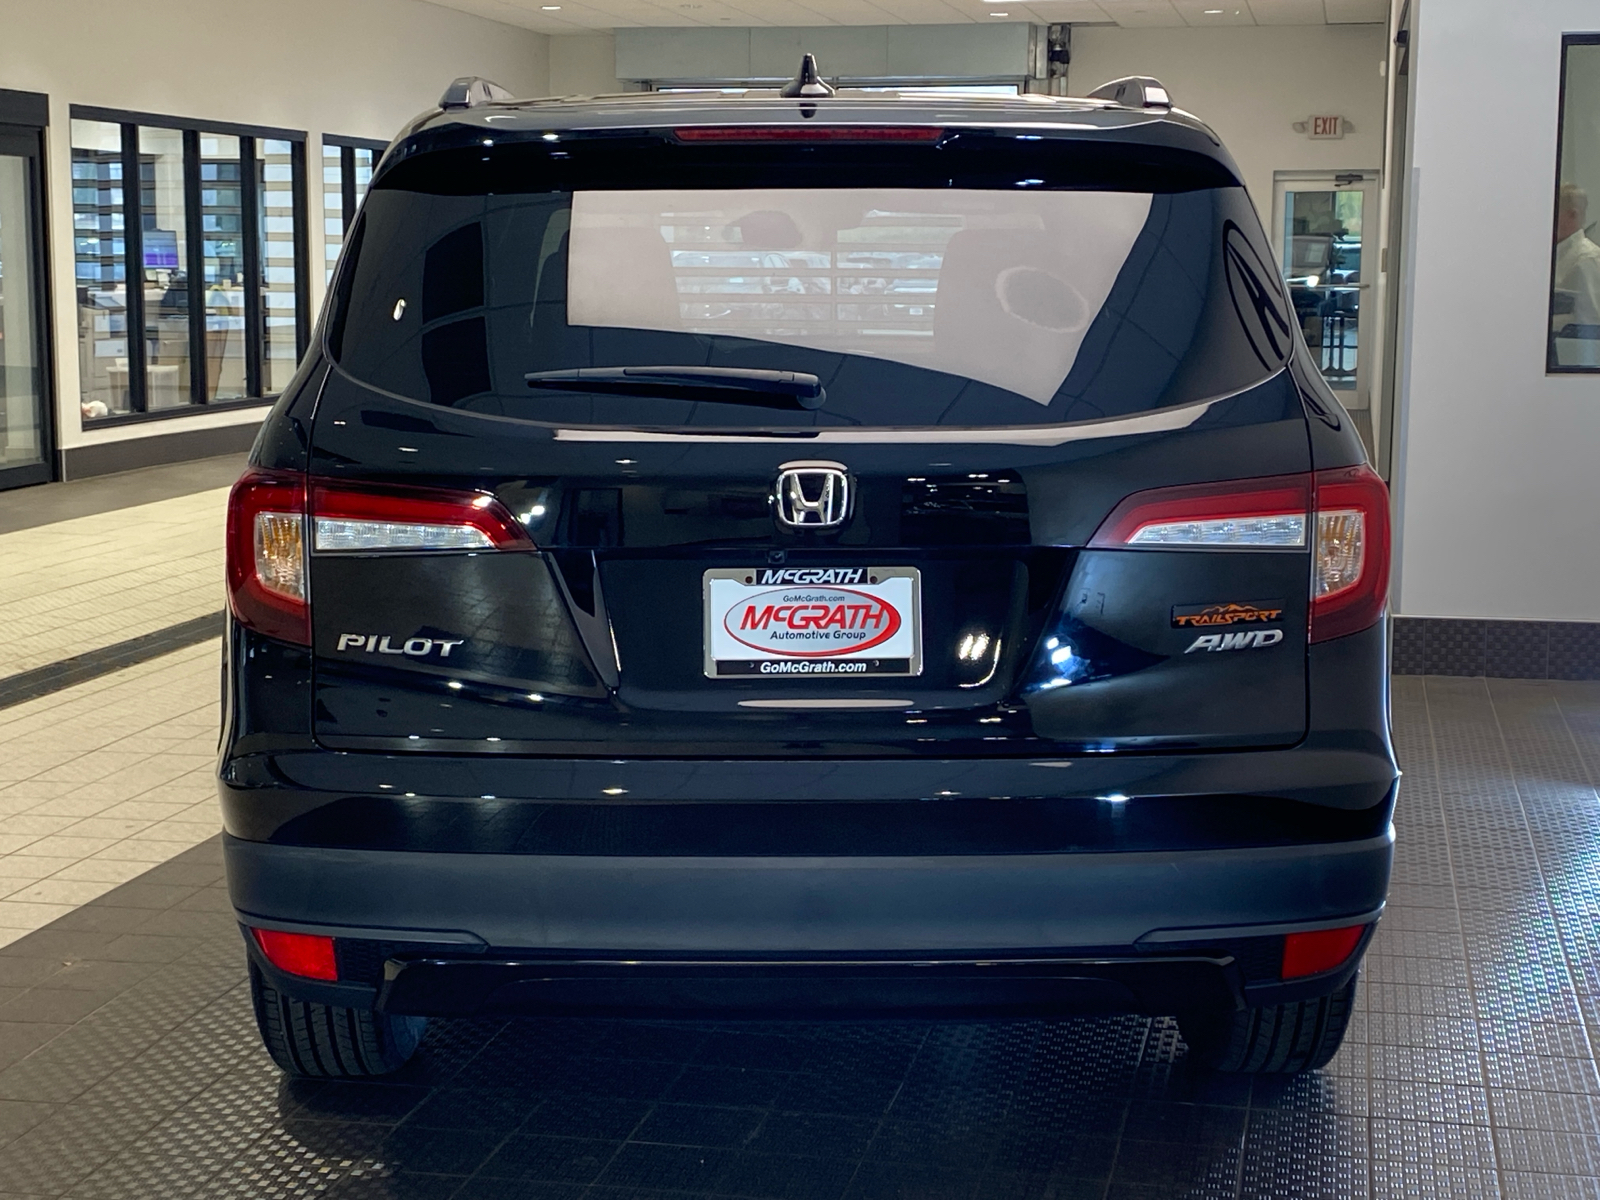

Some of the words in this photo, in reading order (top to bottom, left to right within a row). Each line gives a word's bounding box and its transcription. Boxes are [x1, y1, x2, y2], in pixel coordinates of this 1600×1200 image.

[1314, 117, 1339, 135] EXIT
[761, 569, 862, 584] McGRATH
[783, 594, 845, 603] GoMcGrath.com
[740, 605, 885, 630] McGRATH
[1176, 609, 1282, 626] TRAILSPORT
[770, 630, 830, 640] Automotive
[833, 630, 866, 640] Group
[1183, 629, 1283, 654] AWD
[337, 633, 464, 657] PILOT
[760, 661, 867, 674] GoMcGrath.com
